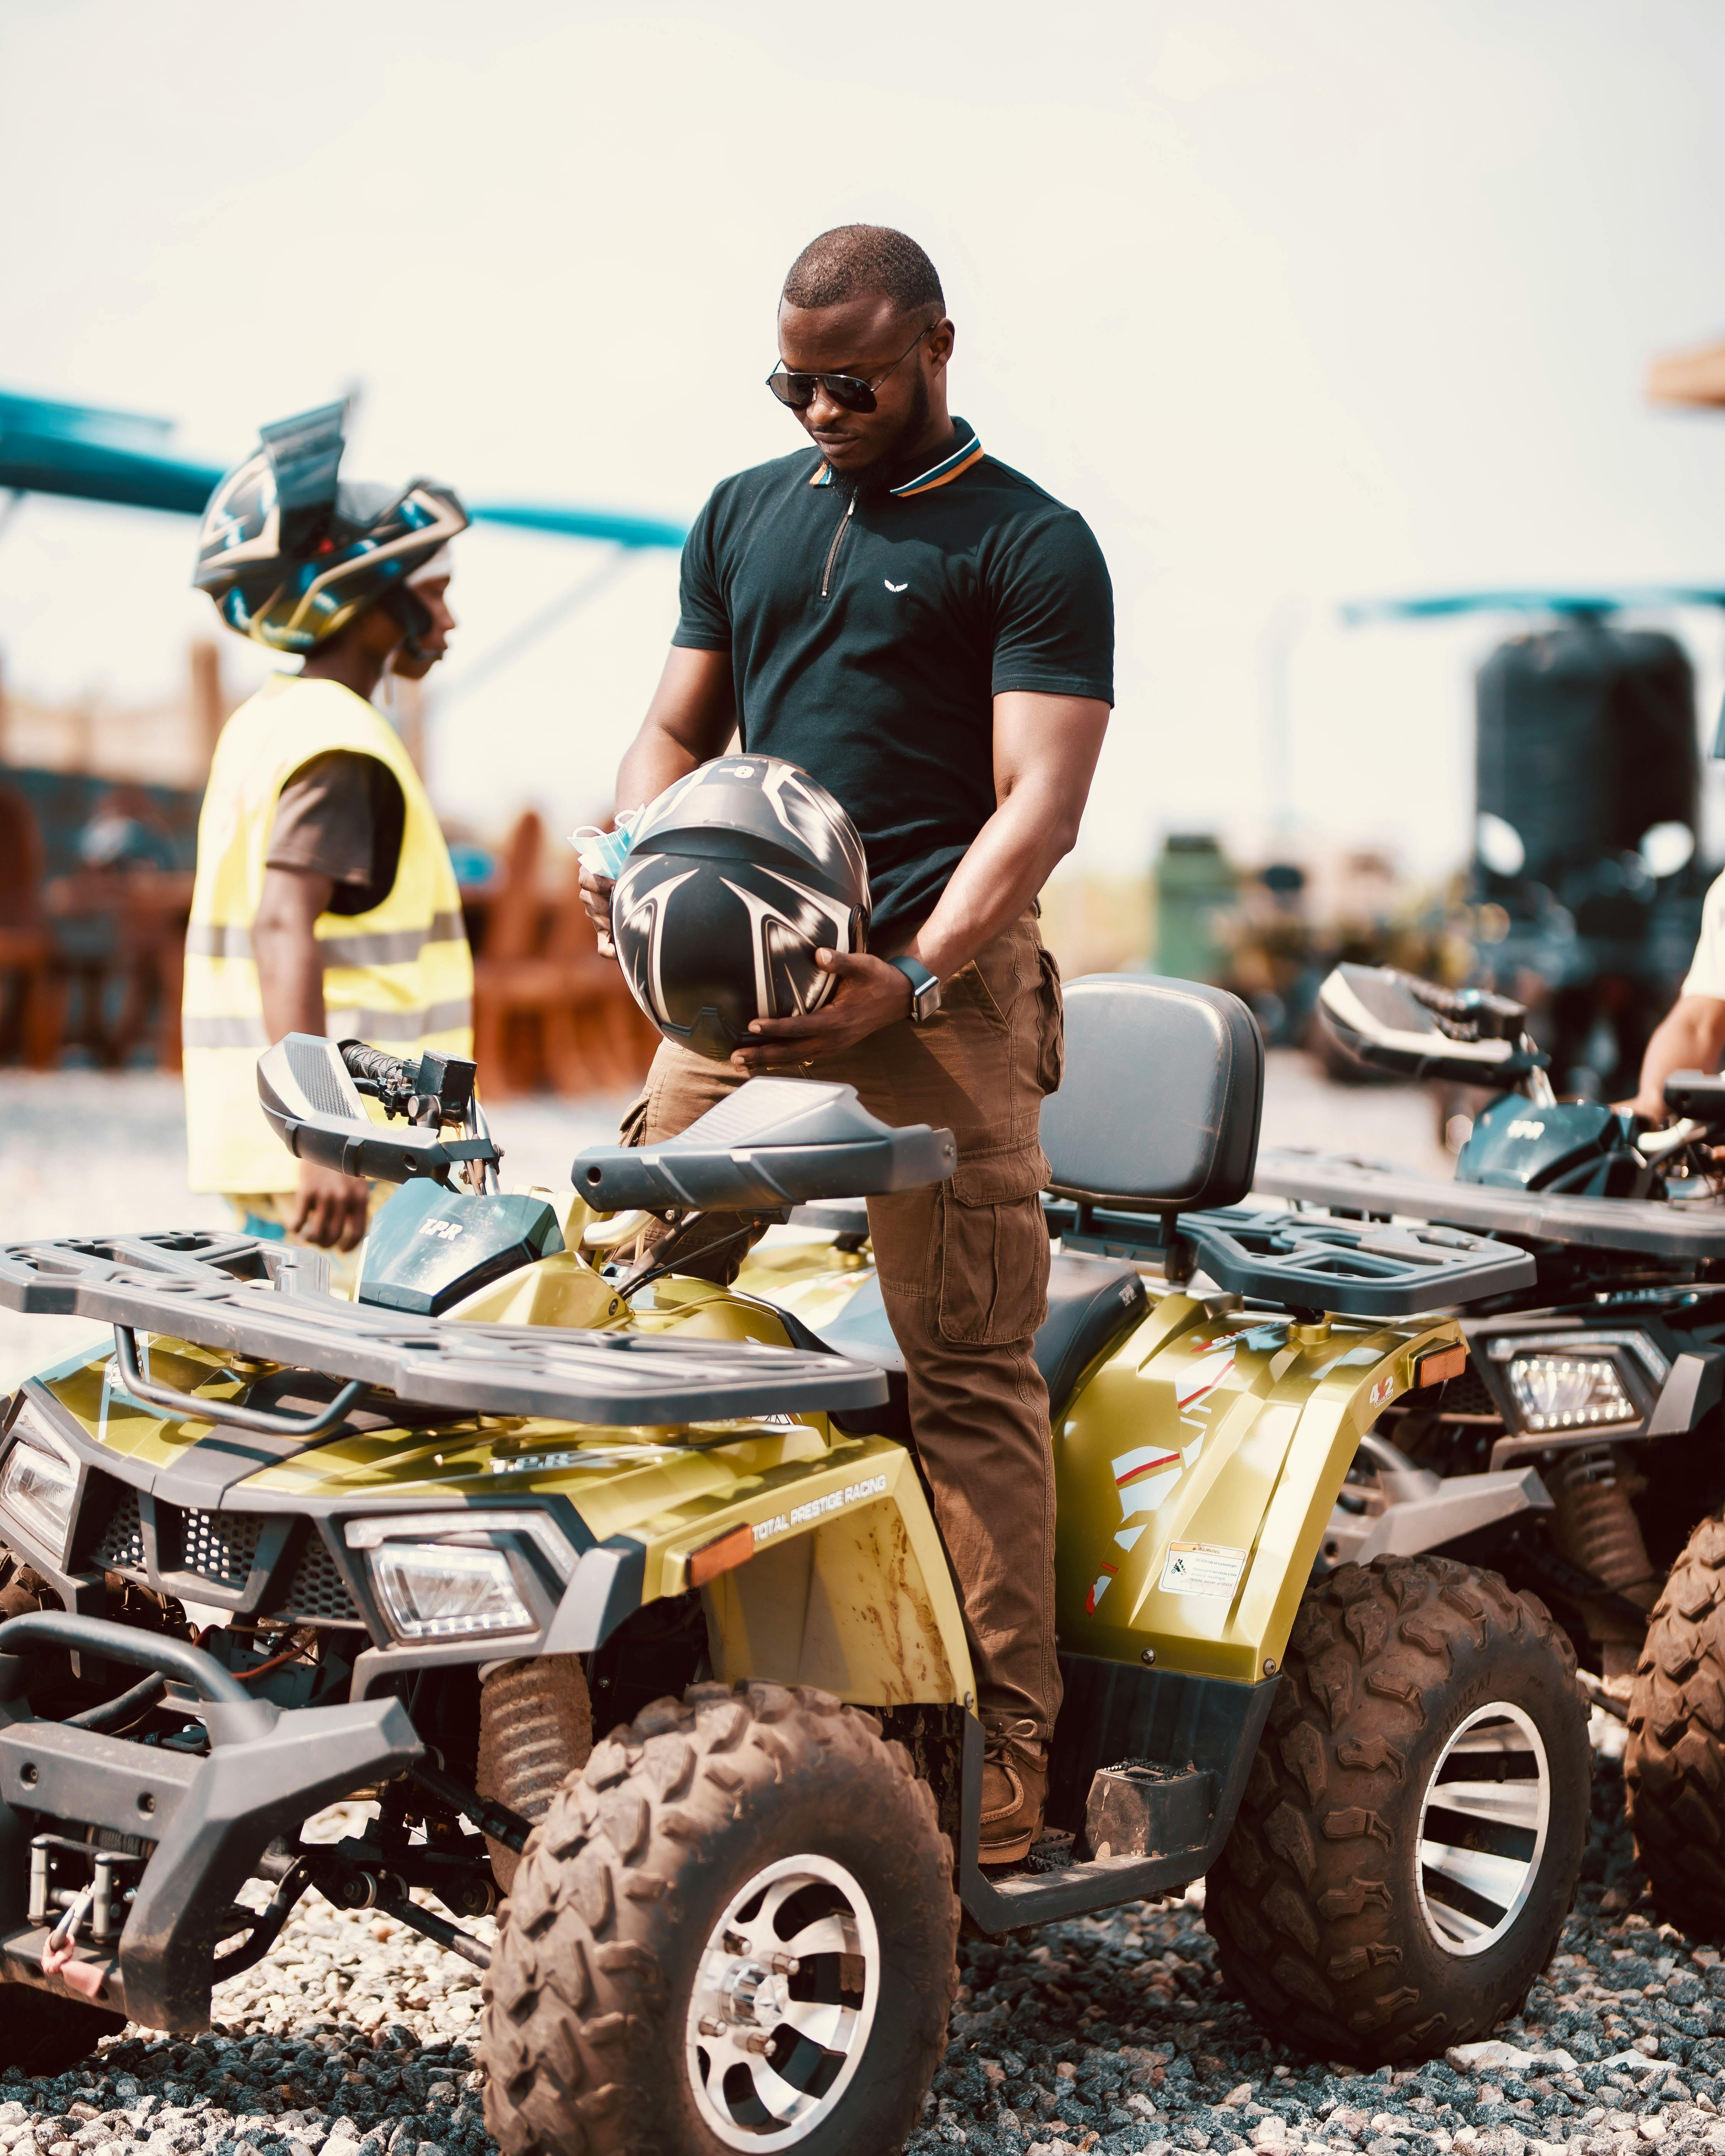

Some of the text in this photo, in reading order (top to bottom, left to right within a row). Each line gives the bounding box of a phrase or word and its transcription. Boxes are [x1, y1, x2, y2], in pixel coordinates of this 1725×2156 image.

[1374, 1391, 1393, 1408] TRACTION
[752, 1473, 887, 1542] TOTAL PRESTIGE RACING
